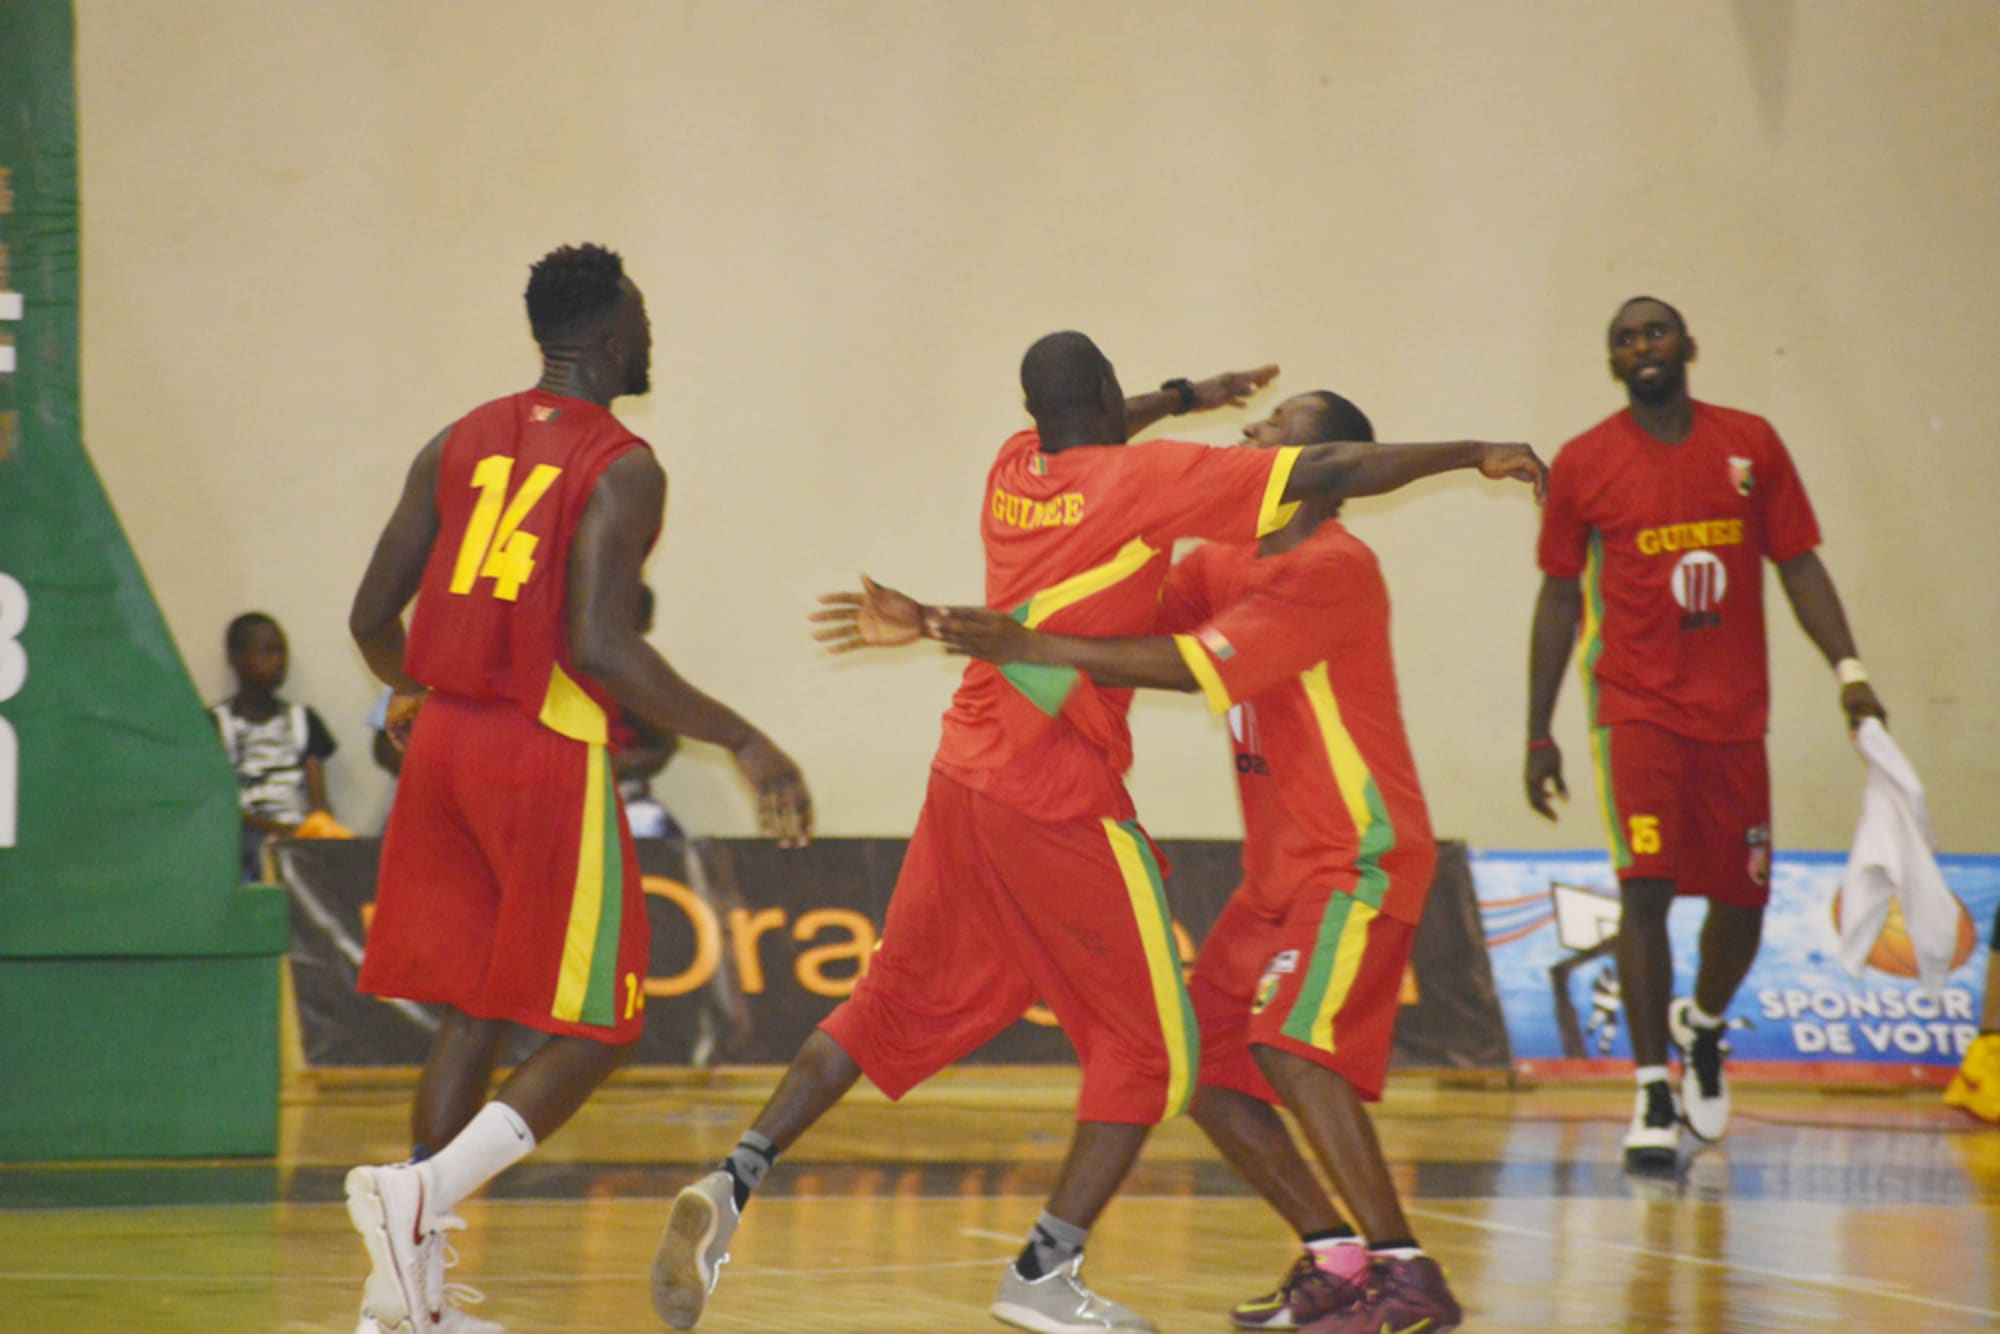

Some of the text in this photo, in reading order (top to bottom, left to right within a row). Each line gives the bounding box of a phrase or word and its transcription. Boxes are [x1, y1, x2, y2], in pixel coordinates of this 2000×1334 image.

[449, 454, 563, 602] 14
[1637, 518, 1744, 555] GUINEE
[1759, 987, 1973, 1020] SPONSOR
[1792, 1022, 1855, 1054] DE
